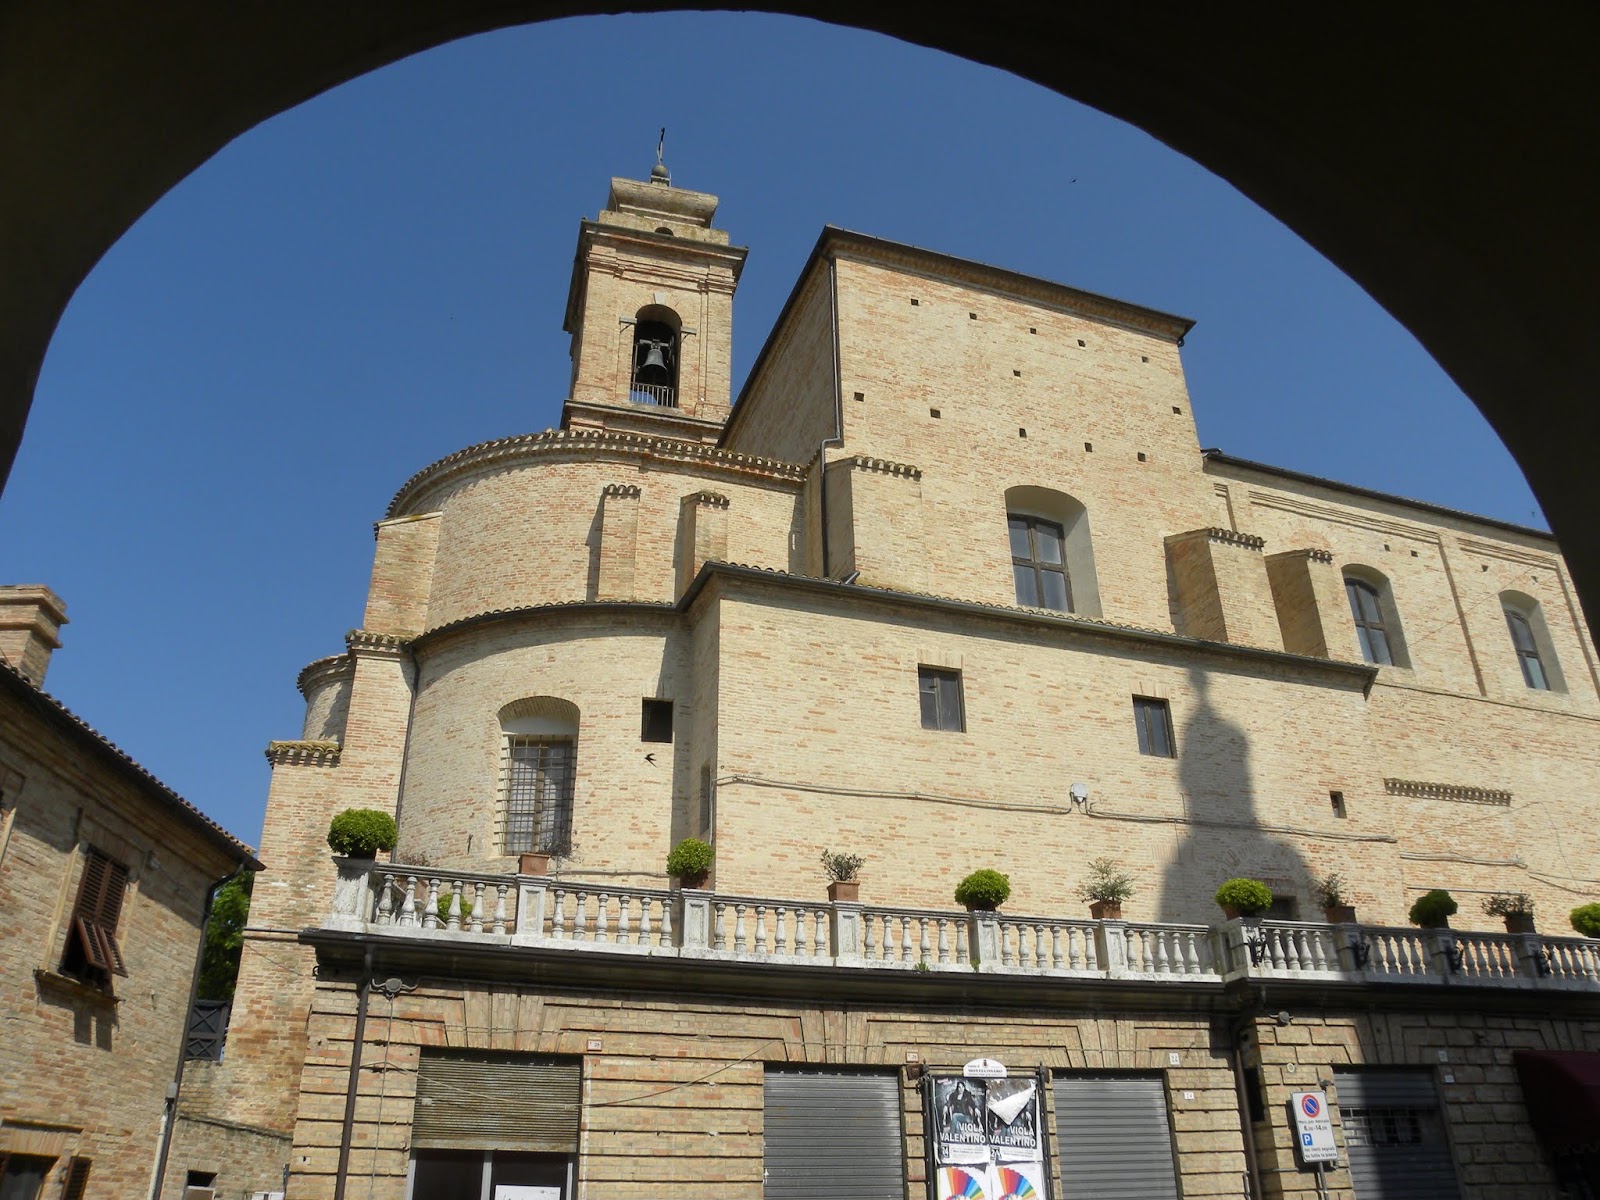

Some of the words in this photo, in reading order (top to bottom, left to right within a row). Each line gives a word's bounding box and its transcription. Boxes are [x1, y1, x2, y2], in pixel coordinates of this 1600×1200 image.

[959, 1123, 984, 1132] VIOLA
[1010, 1126, 1035, 1136] VIOLA
[940, 1132, 986, 1143] VALENTINO
[989, 1135, 1036, 1147] VALENTINO
